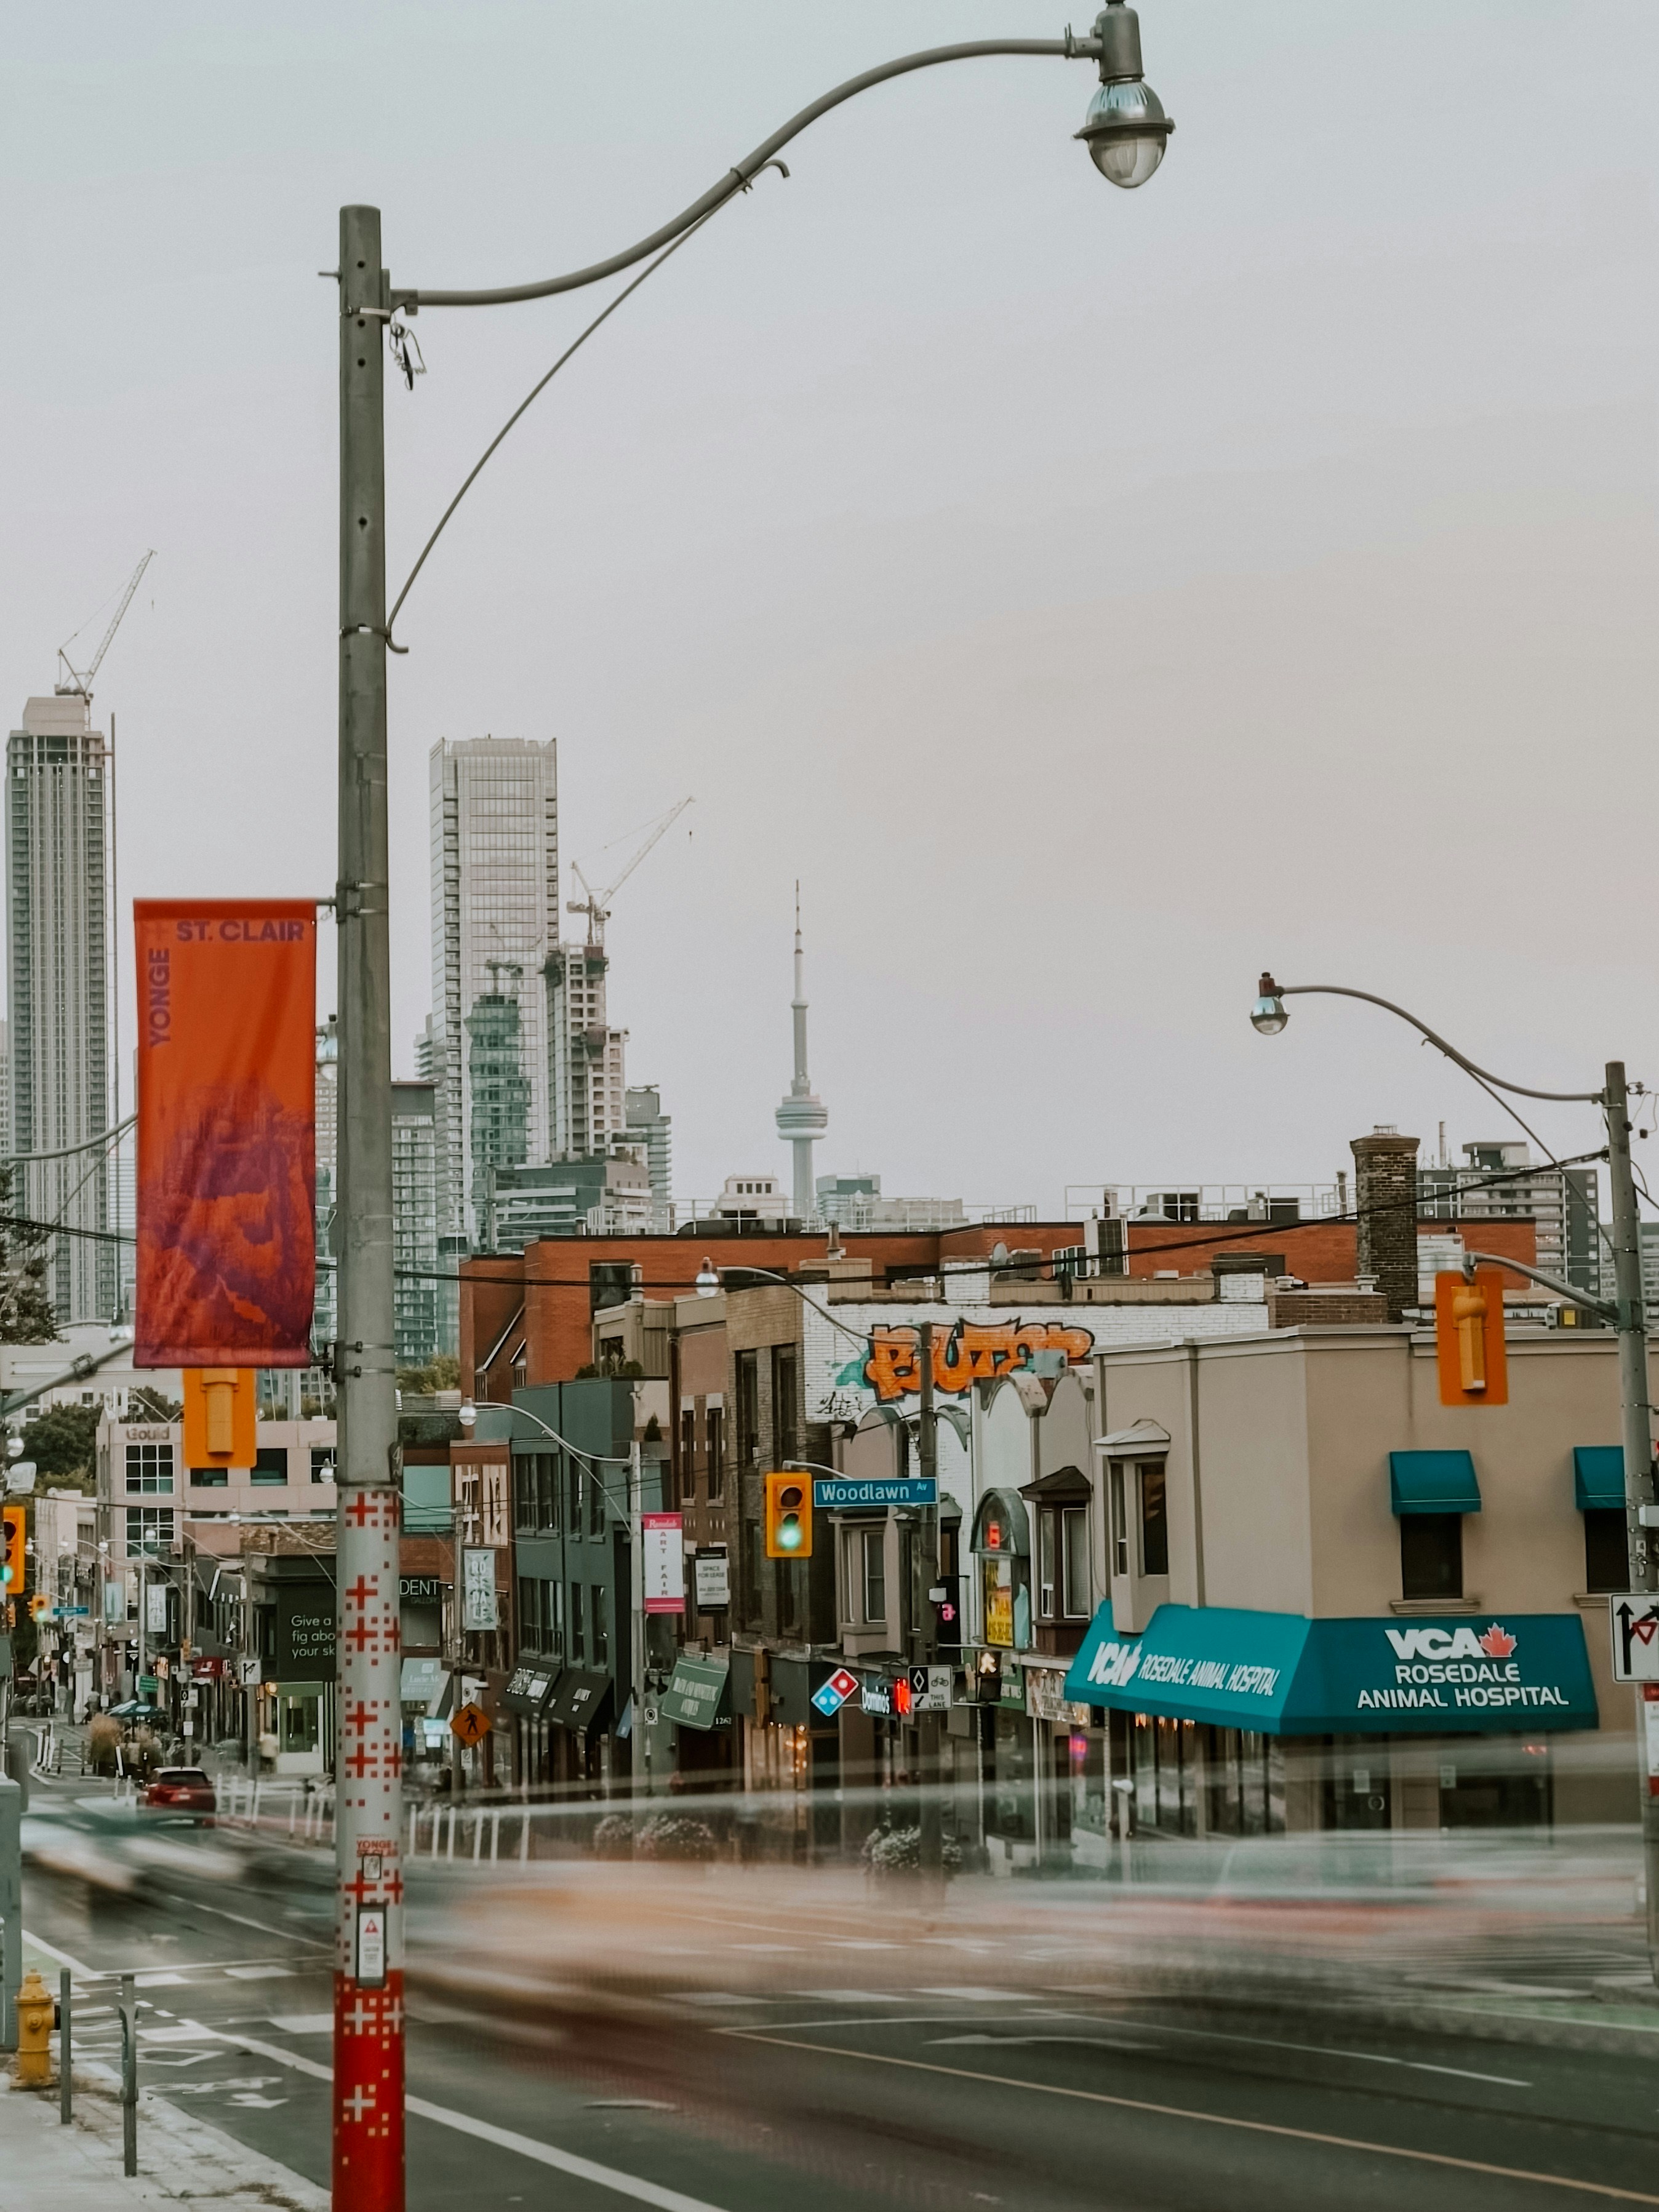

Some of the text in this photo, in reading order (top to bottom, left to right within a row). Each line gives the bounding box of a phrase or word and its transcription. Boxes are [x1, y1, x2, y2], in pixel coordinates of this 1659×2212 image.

[177, 920, 304, 941] ST. CLAIR
[148, 948, 170, 1047] YONGE
[822, 1482, 927, 1501] Woodlawn Av
[400, 1579, 439, 1595] DENT
[291, 1615, 319, 1626] Give
[292, 1629, 335, 1644] fig abo
[1385, 1628, 1486, 1660] VCA
[292, 1645, 335, 1659] your sk
[1087, 1641, 1131, 1687] VCA
[1395, 1664, 1521, 1684] ROSEDALE
[1138, 1654, 1280, 1696] ROSEDALE ANIMAL HOSPITAL
[862, 1685, 890, 1714] Domino's
[1357, 1687, 1569, 1708] ANIMAL HOSPITAL
